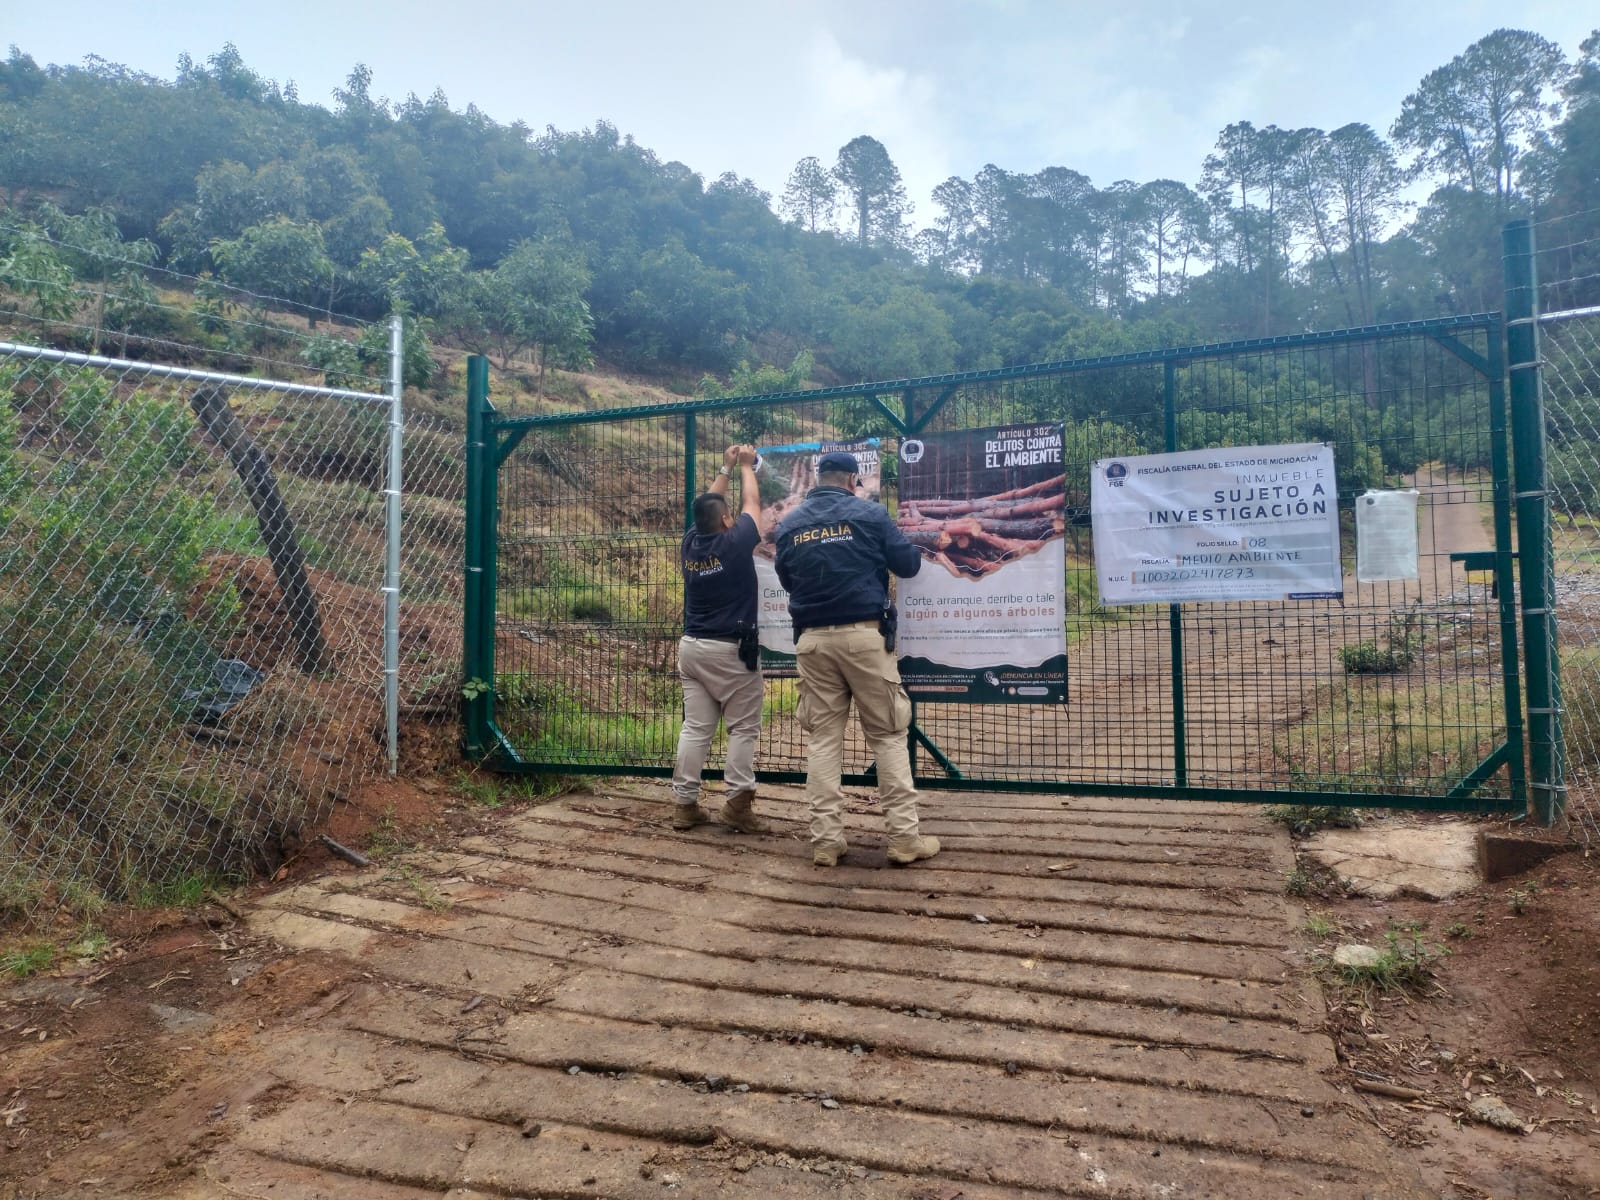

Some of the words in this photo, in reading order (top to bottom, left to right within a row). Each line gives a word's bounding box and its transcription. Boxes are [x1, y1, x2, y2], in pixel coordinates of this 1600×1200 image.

[997, 429, 1031, 439] ARTÍCULO
[985, 439, 1024, 453] DELITOS
[1026, 434, 1062, 450] CONTRA
[985, 454, 1001, 469] EL
[1004, 448, 1062, 467] AMBIENTE
[1137, 467, 1170, 475] FISCALÍA
[1171, 463, 1207, 472] GENERAL
[1208, 461, 1223, 470] DEL
[1225, 458, 1256, 468] ESTADO
[1257, 458, 1268, 466] DE
[1109, 480, 1124, 488] FGE
[1236, 468, 1325, 484] INMUEBLE
[1214, 485, 1299, 504] SUJETO
[1312, 482, 1326, 496] A
[1148, 498, 1326, 524] INVESTIGACIÓN
[793, 522, 852, 547] FISCALÍA
[1248, 537, 1267, 548] 08
[1182, 553, 1222, 566] MEDIO
[1228, 551, 1303, 564] AMBIENTE
[986, 594, 1023, 604] derribe
[1026, 595, 1033, 603] o
[1035, 593, 1055, 603] tale
[905, 608, 938, 621] algún
[942, 610, 950, 618] o
[953, 608, 1003, 621] algunos
[1007, 606, 1055, 617] árboles
